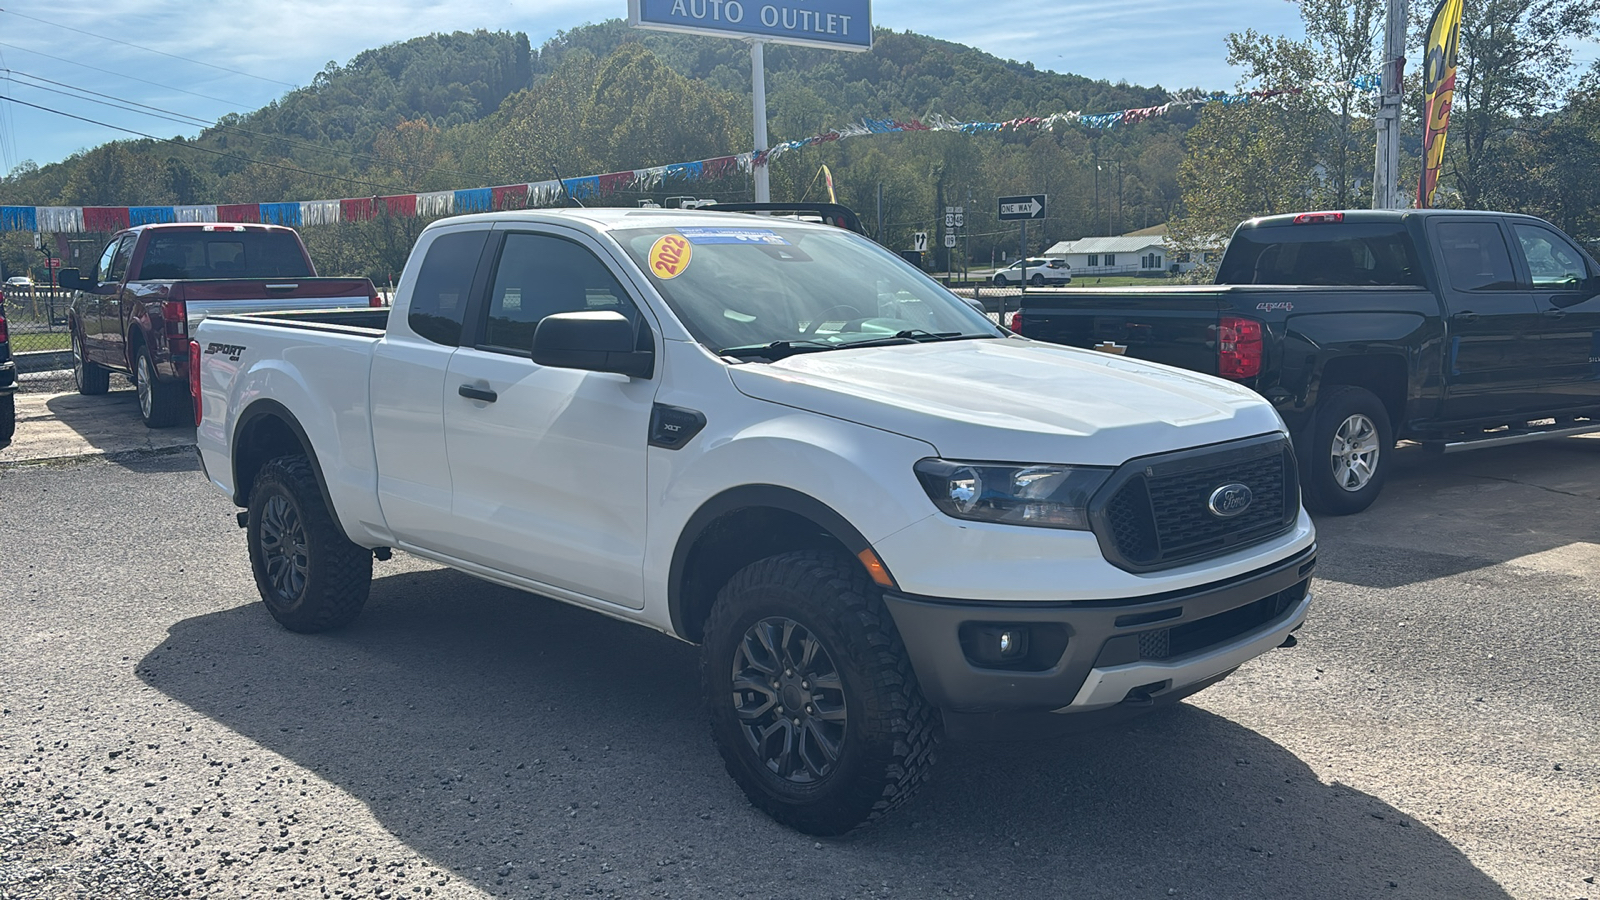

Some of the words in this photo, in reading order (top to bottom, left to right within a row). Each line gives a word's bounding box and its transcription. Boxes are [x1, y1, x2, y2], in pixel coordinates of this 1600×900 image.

[671, 0, 744, 23] AUTO
[760, 5, 851, 35] OUTLET
[1002, 204, 1015, 213] ONE
[1018, 203, 1033, 212] WAY
[946, 215, 954, 224] 33
[946, 236, 954, 246] 119
[655, 236, 686, 275] 2022
[204, 342, 247, 356] SPORT
[664, 423, 681, 432] XLT
[1223, 489, 1247, 510] Ford
